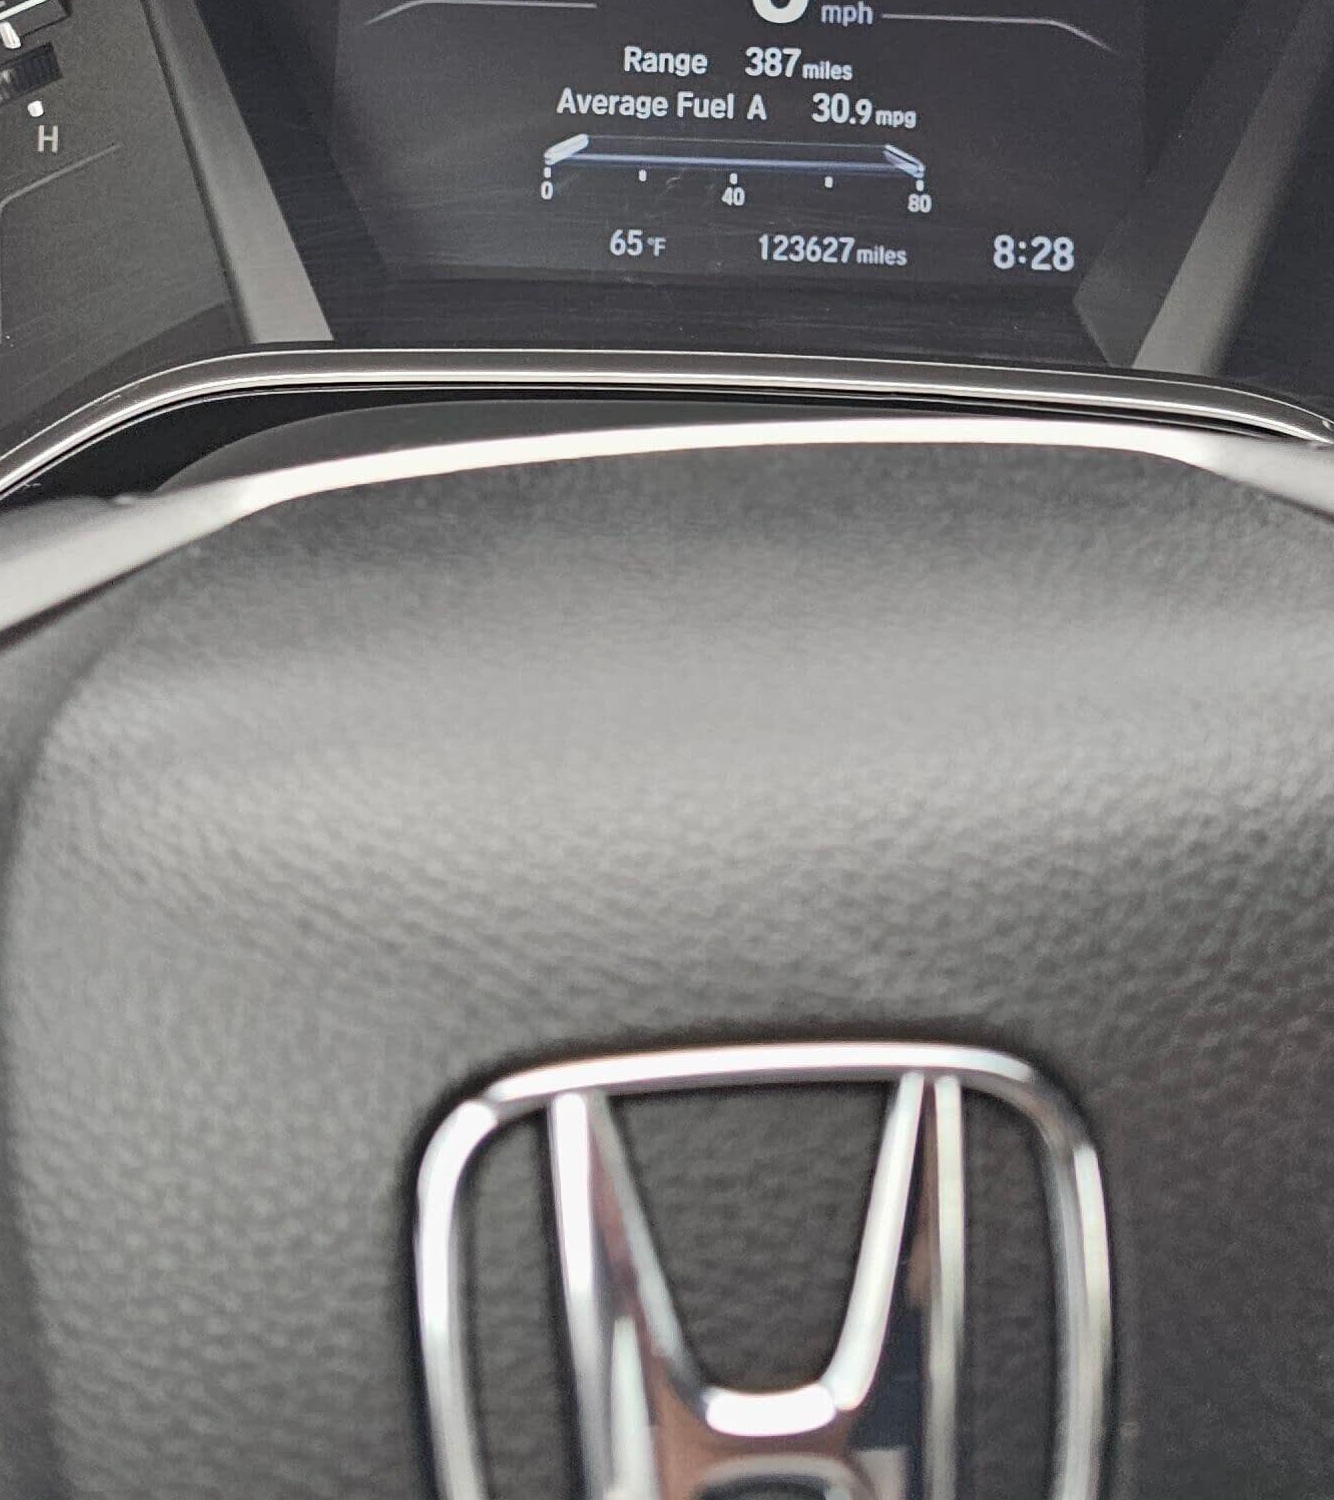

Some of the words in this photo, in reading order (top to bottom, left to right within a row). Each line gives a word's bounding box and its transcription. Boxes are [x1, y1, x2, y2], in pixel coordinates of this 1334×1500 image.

[820, 1, 873, 27] mph
[624, 46, 708, 76] Range
[556, 87, 668, 119] Average
[676, 91, 735, 119] Fuel
[746, 97, 767, 120] A
[37, 124, 59, 153] H
[540, 181, 554, 200] 0
[722, 187, 745, 206] 40
[907, 194, 932, 213] 80
[993, 234, 1075, 272] 8:28
